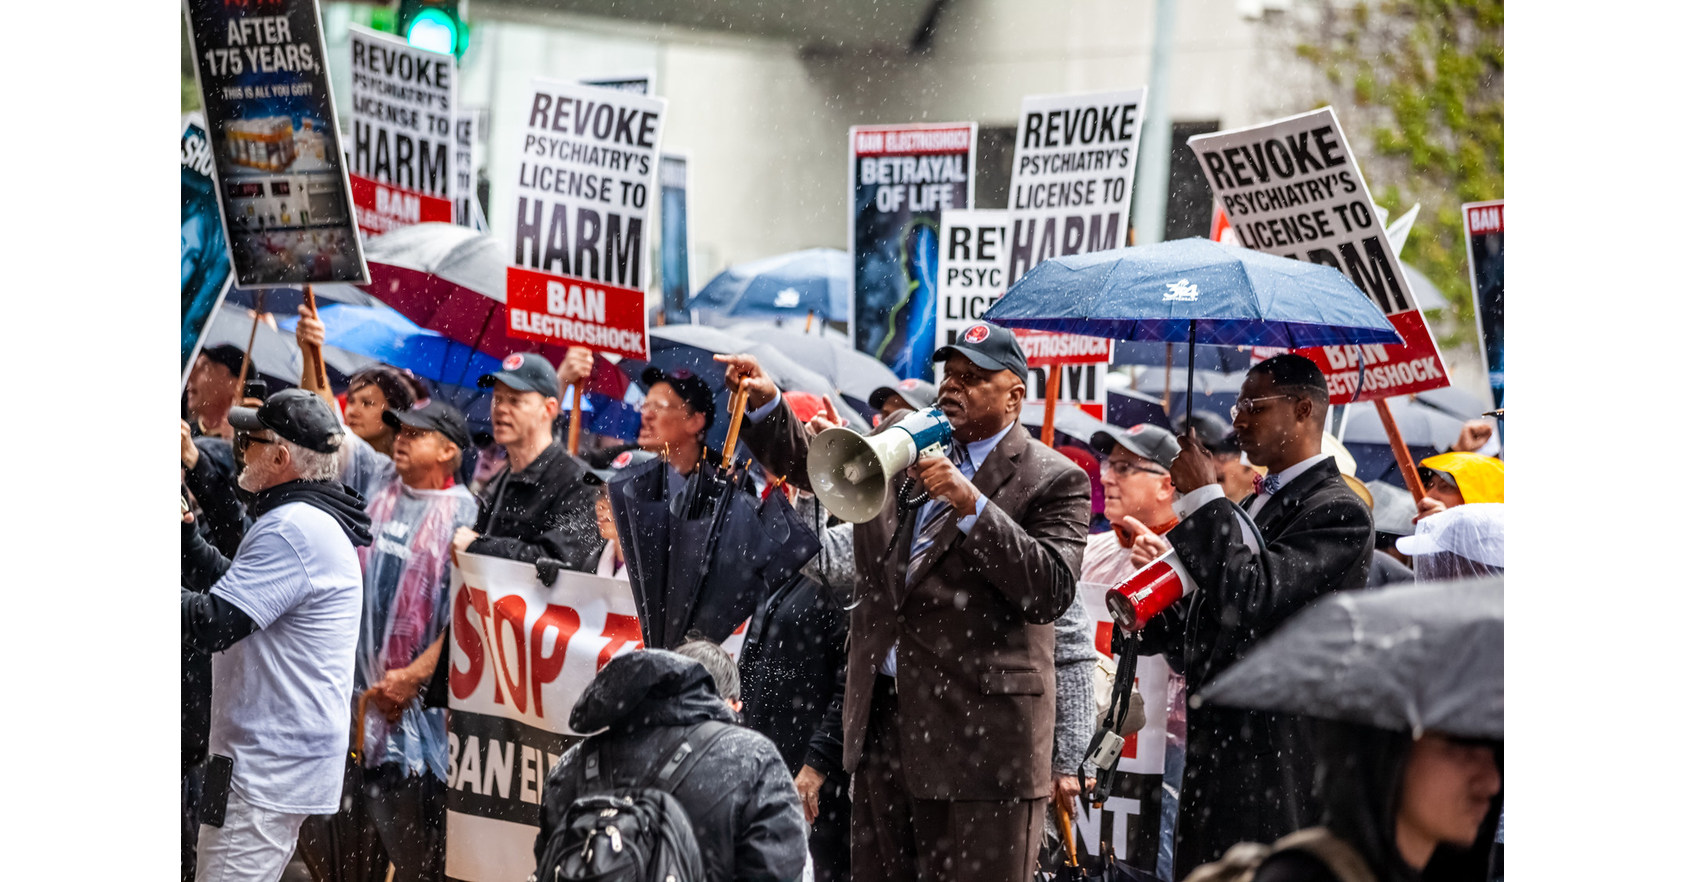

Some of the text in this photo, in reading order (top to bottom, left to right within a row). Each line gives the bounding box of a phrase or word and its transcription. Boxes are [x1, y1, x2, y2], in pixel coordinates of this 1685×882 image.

[227, 15, 292, 46] AFTER
[204, 42, 320, 76] 175 YEARS,
[353, 38, 449, 91] REVOKE
[352, 93, 420, 132] LICENSE
[426, 113, 450, 136] TO
[529, 91, 659, 149] REVOKE
[1023, 103, 1137, 150] REVOKE
[355, 119, 448, 198] HARM
[524, 134, 650, 176] PSYCHIATRY'S
[885, 128, 968, 152] ELECTROSHOCK
[1019, 148, 1129, 176] PSYCHIATRY'S
[1203, 125, 1346, 190] REVOKE
[519, 162, 648, 209] LICENSE TO
[860, 153, 967, 185] BETRAYAL
[374, 185, 421, 224] BAN
[876, 181, 955, 213] OF LIFE
[1015, 176, 1125, 211] LICENSE TO
[1223, 171, 1357, 217] PSYCHIATRY'S
[1235, 201, 1372, 250] LICENSE TO
[1470, 207, 1500, 232] BAN
[515, 196, 643, 290] HARM
[546, 280, 606, 324] BAN
[510, 308, 644, 353] ELECTROSHOCK
[449, 585, 581, 719] STOP
[447, 731, 515, 800] BAN
